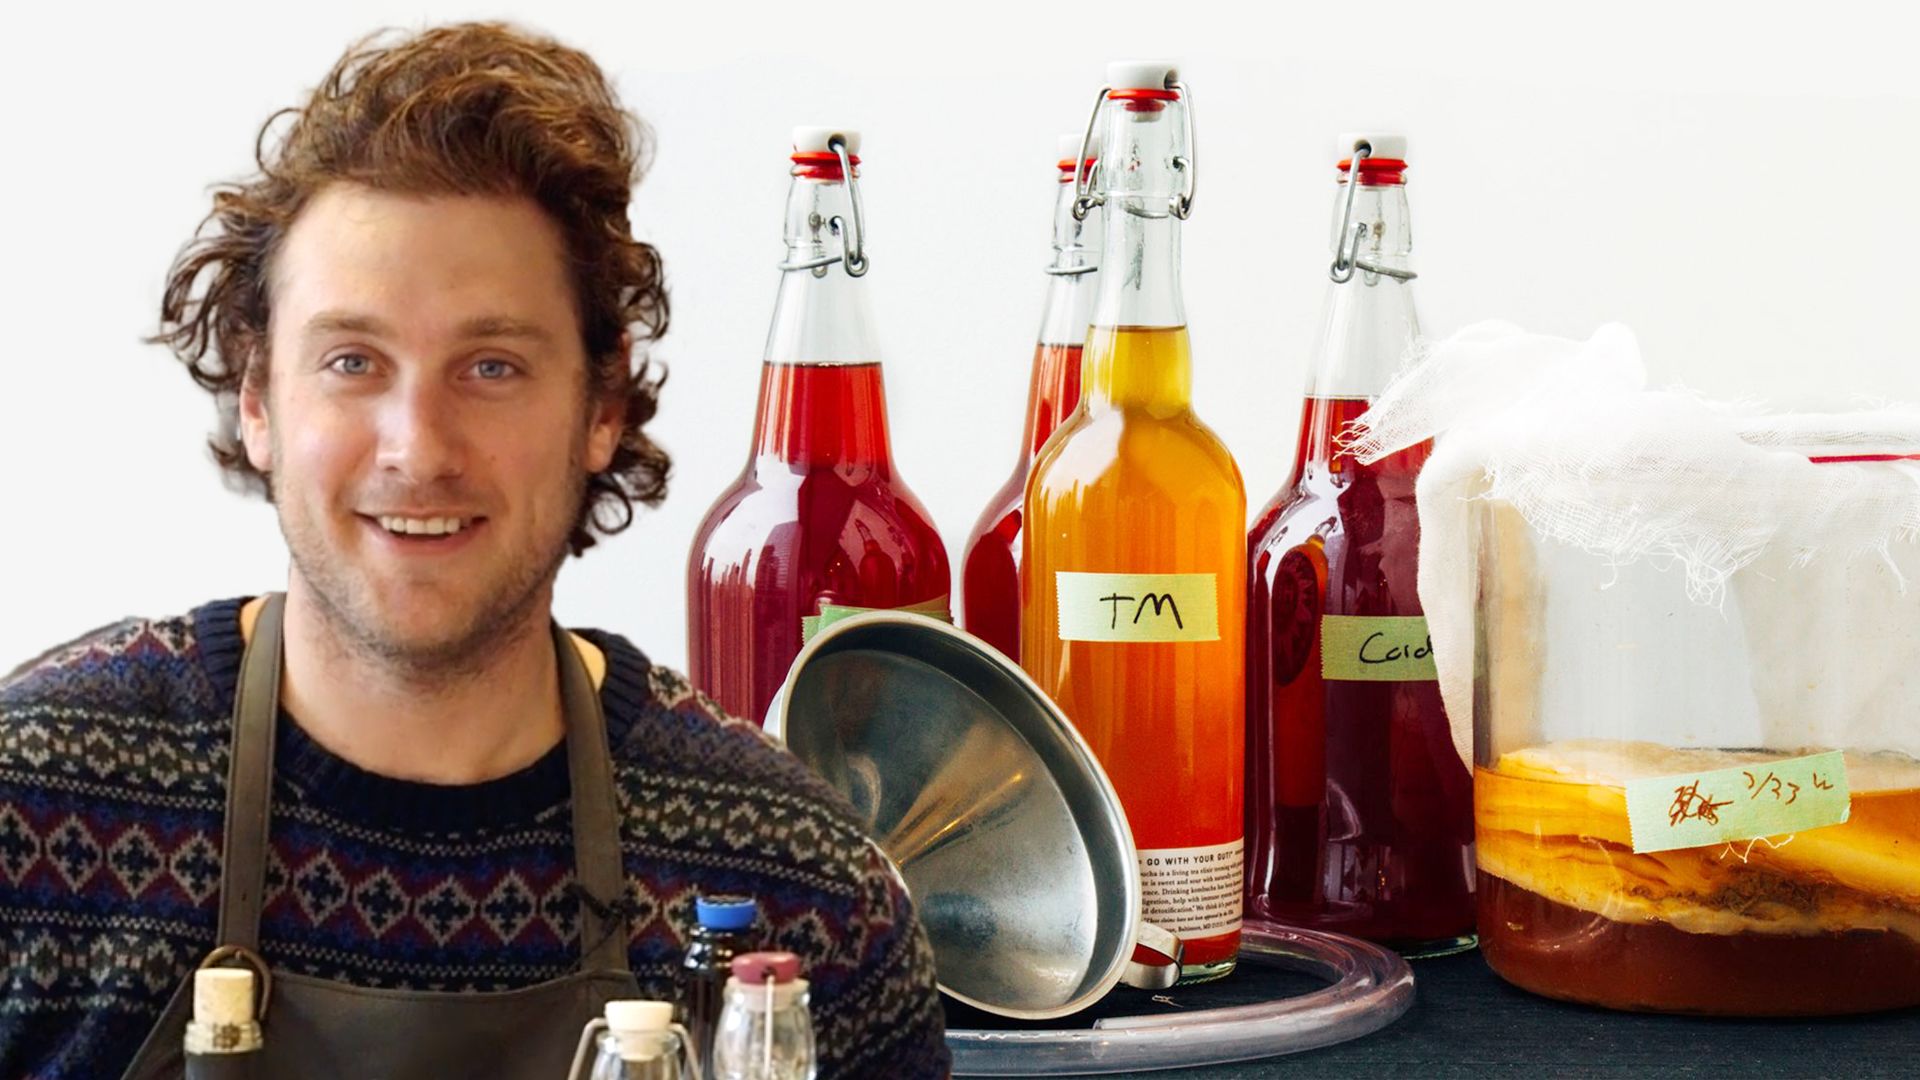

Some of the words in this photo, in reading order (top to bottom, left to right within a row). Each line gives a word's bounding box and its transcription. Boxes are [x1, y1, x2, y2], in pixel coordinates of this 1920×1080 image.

[1099, 592, 1183, 630] TM
[1146, 858, 1160, 866] GO
[1165, 857, 1189, 865] WITH
[1193, 854, 1214, 863] YOUR
[1172, 869, 1189, 877] living
